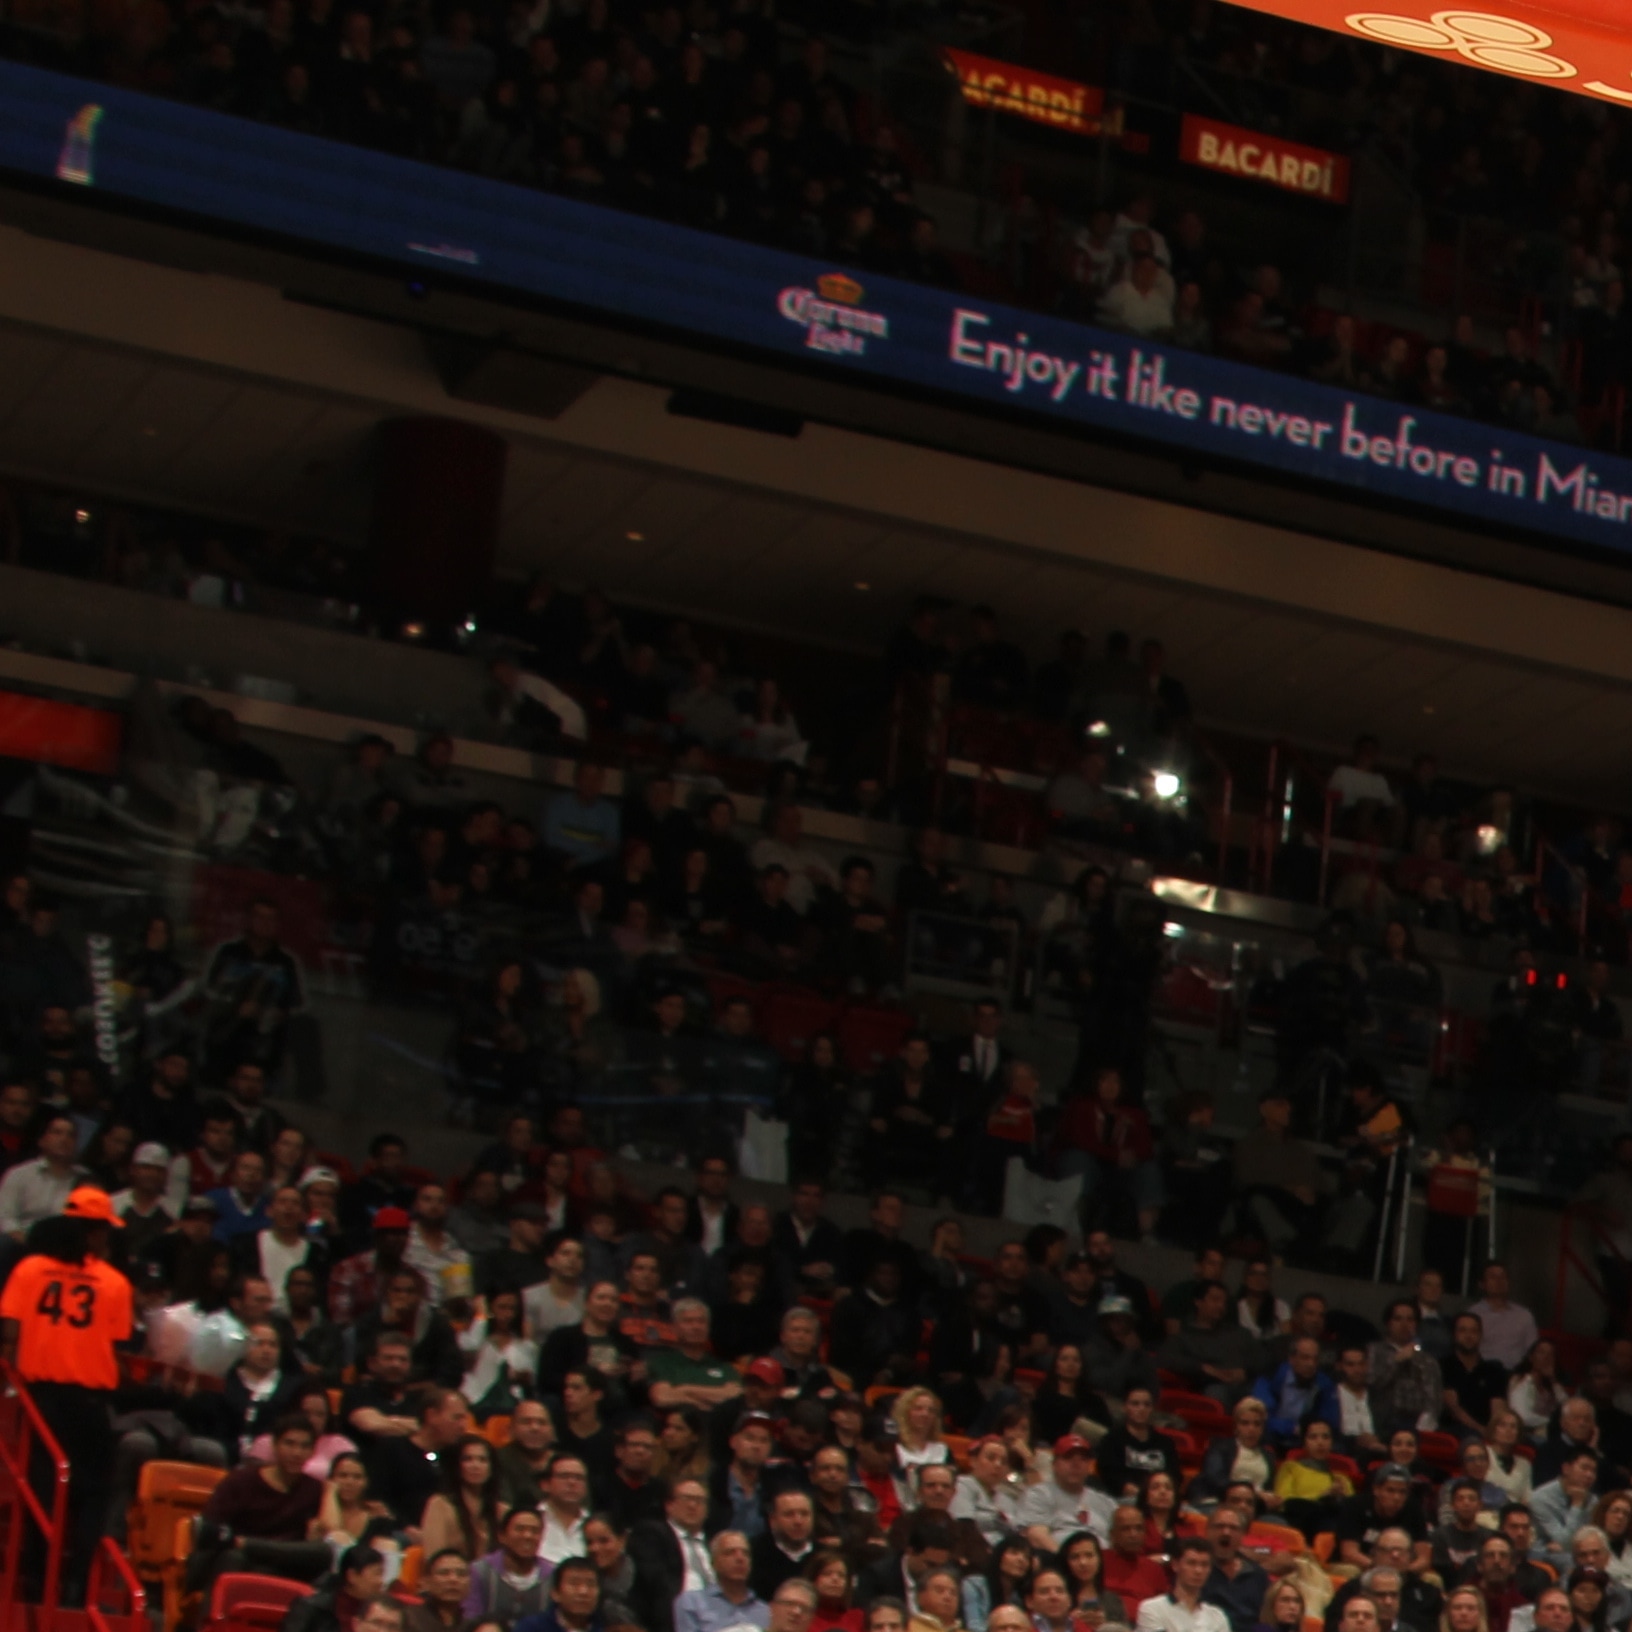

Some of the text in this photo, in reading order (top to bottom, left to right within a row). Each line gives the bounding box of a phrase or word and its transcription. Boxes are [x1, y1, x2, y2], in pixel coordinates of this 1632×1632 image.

[949, 306, 1081, 401] Enjoy
[1086, 350, 1117, 401] it
[1126, 349, 1202, 420] like
[1210, 397, 1333, 450] never
[1341, 403, 1479, 488] before
[1489, 449, 1526, 499] in
[37, 1280, 96, 1329] 43
